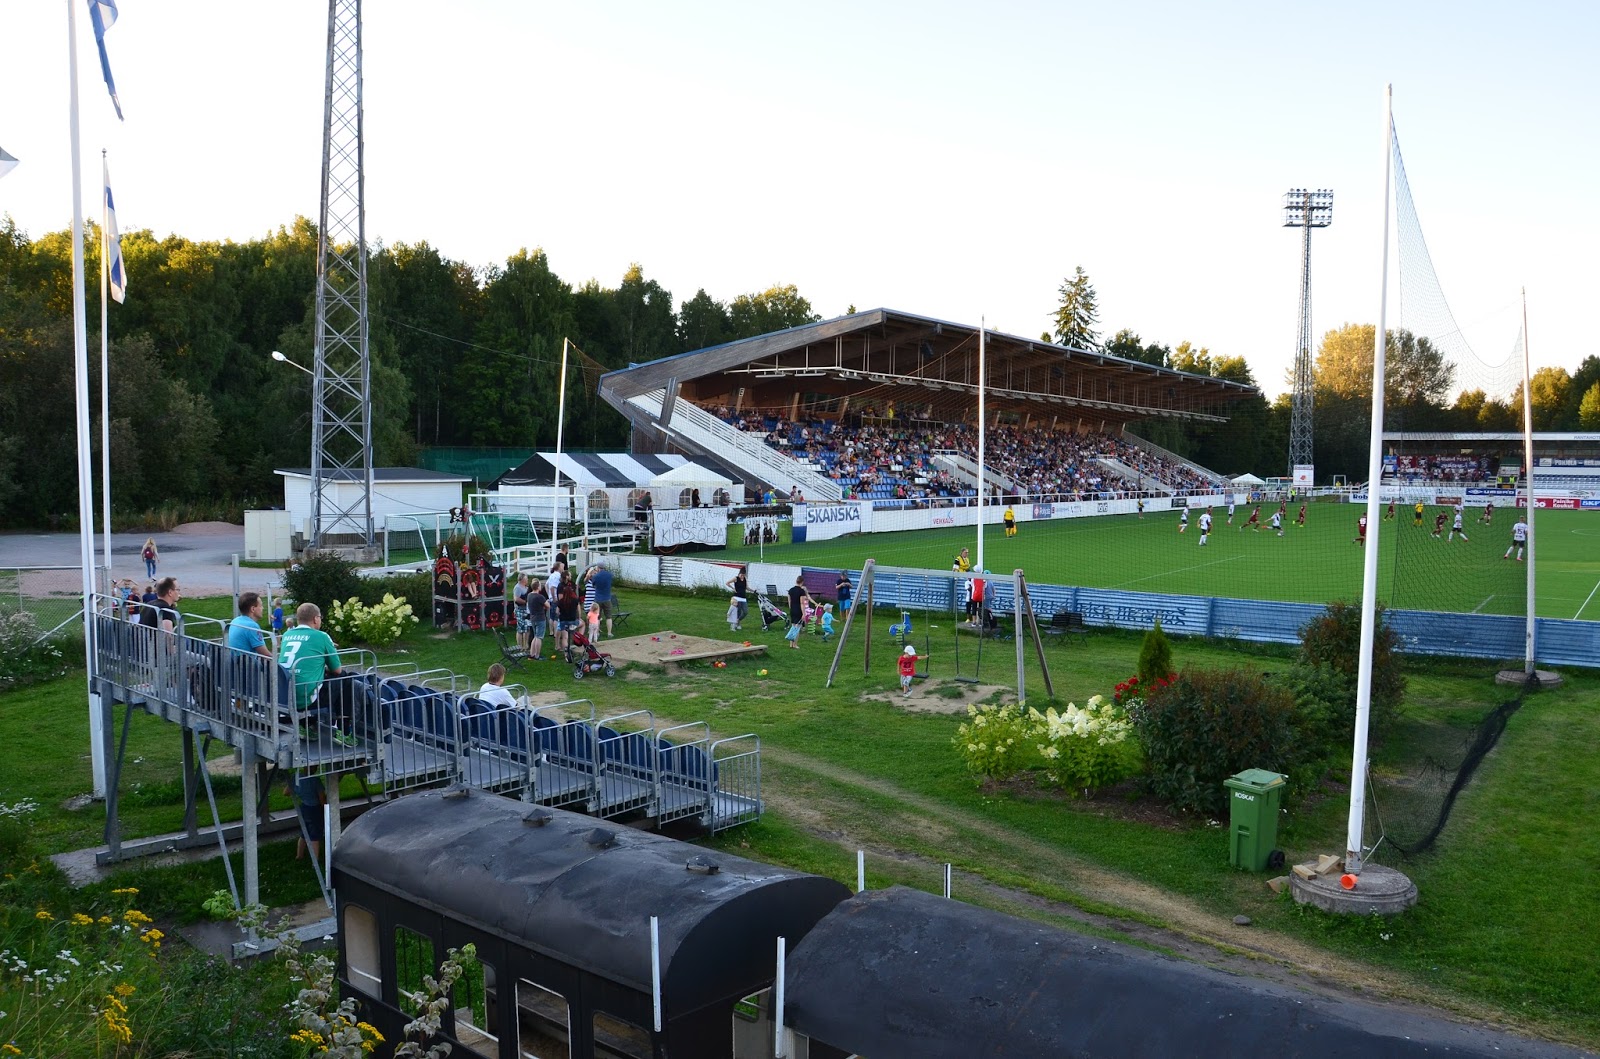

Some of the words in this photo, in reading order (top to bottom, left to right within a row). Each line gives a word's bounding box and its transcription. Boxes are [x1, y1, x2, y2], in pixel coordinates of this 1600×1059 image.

[656, 512, 669, 523] ON
[807, 507, 860, 523] SKANSKA
[933, 517, 954, 525] VEIKKAUS
[279, 641, 302, 669] 3
[1235, 792, 1254, 801] ROSKAT
